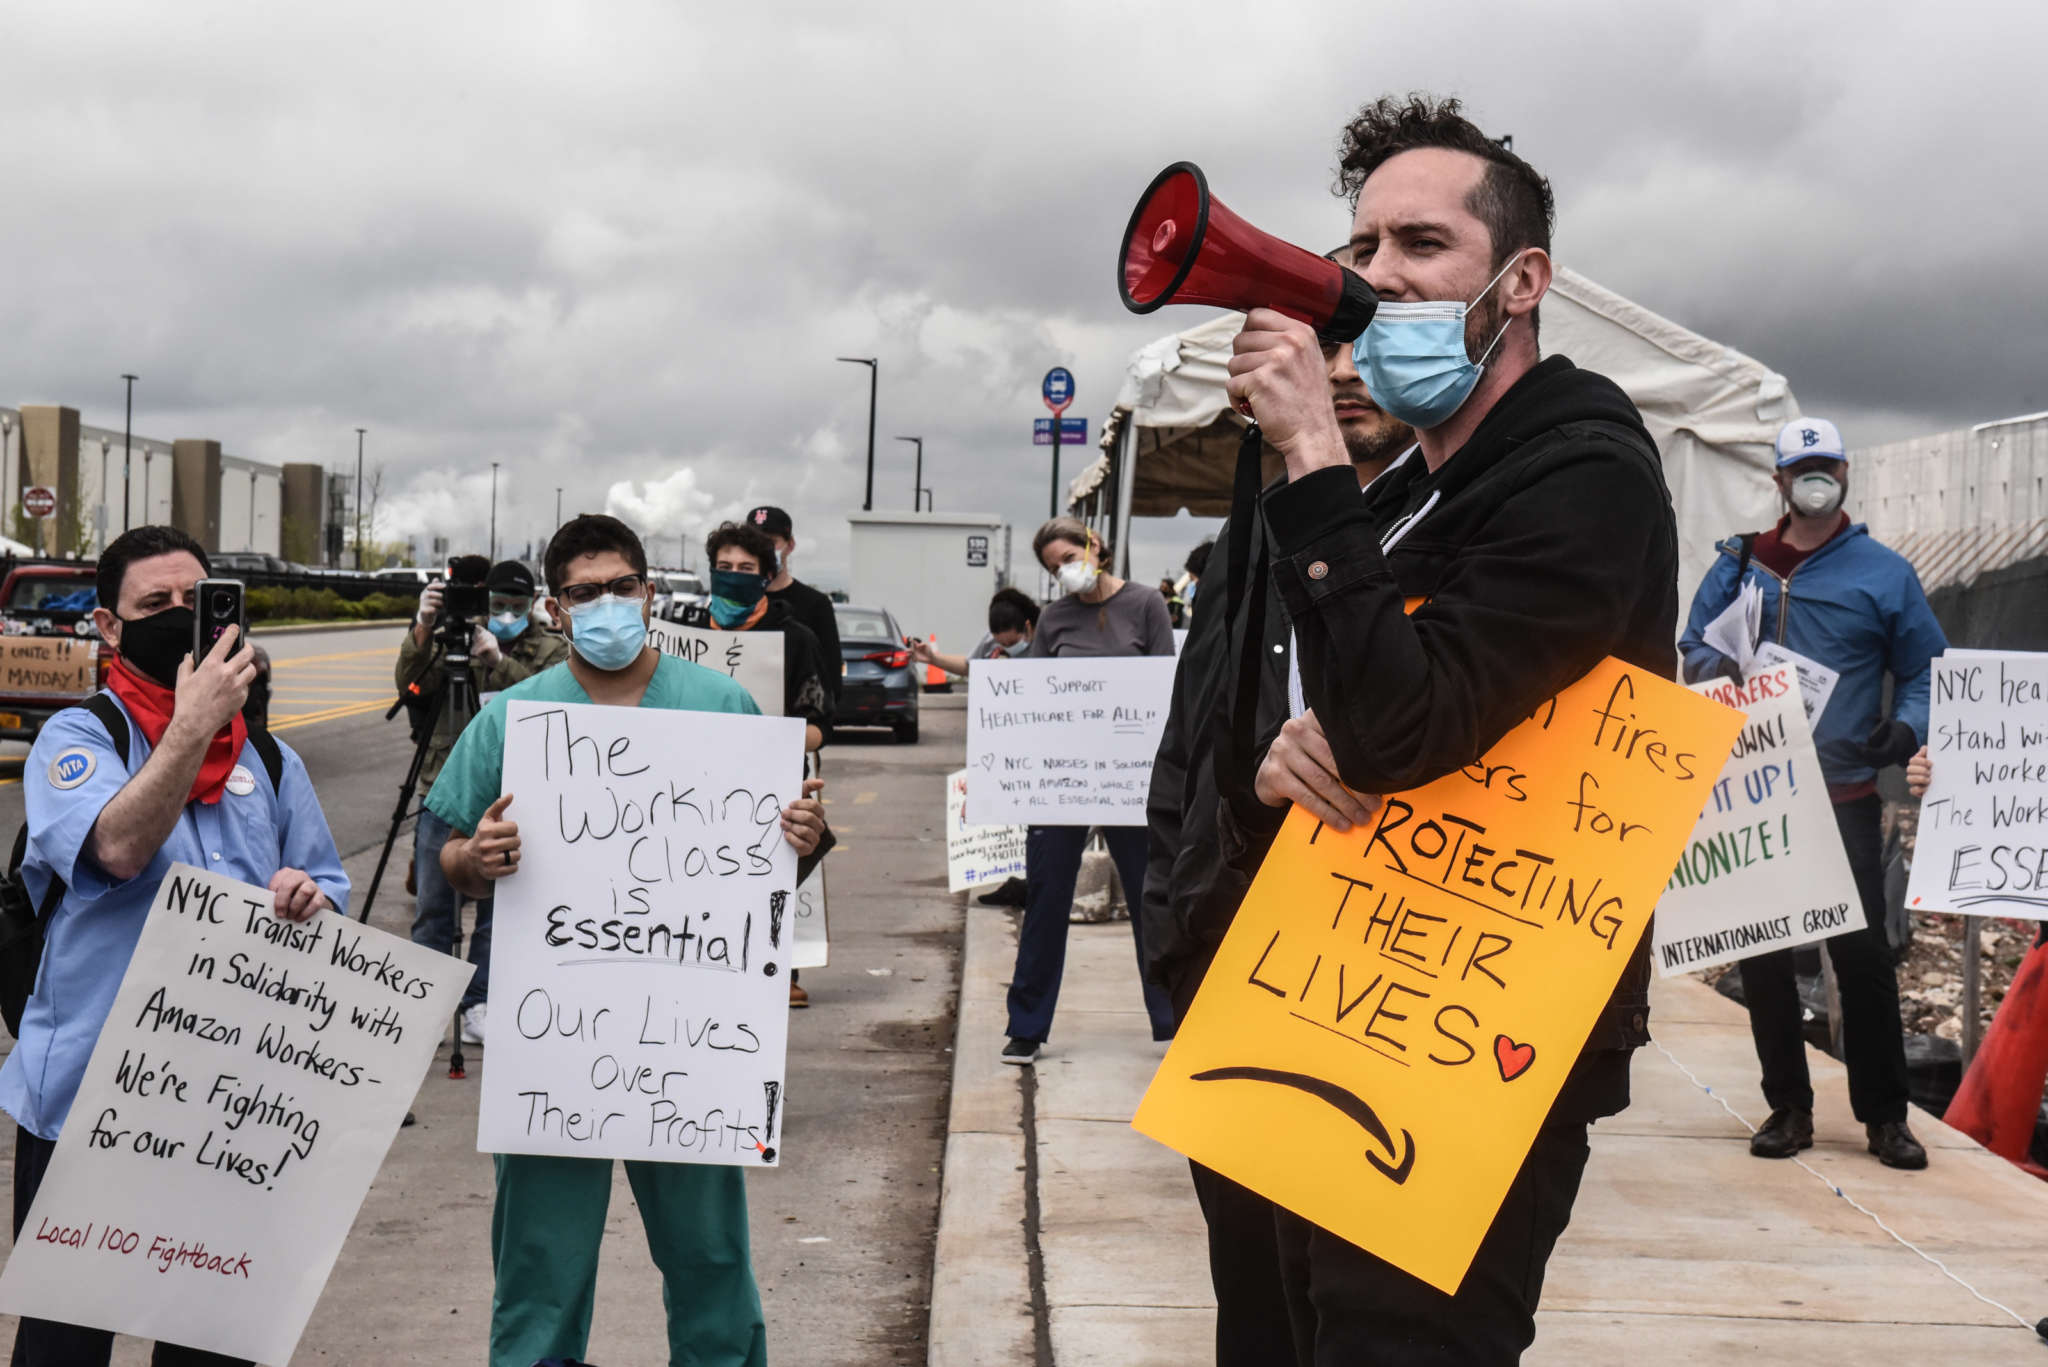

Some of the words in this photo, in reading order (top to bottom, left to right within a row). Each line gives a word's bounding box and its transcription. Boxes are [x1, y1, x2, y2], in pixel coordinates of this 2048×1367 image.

[649, 629, 709, 664] TRUMP
[987, 676, 1025, 697] WE
[1705, 670, 1790, 709] ORKERS
[1937, 666, 1983, 704] NYC
[517, 709, 650, 781] The
[979, 707, 1075, 730] HEALTHCARE
[1083, 708, 1105, 720] FOR
[1593, 674, 1697, 783] fires
[1938, 719, 2006, 751] Stand
[57, 759, 84, 779] MTA
[1000, 780, 1032, 792] WITH
[1004, 757, 1033, 771] NYC
[1043, 758, 1089, 770] NURSES
[1745, 759, 1798, 804] UP!
[559, 781, 785, 868] Working
[1567, 771, 1653, 843] for
[1927, 797, 1974, 829] The
[628, 836, 774, 884] Class
[1662, 814, 1791, 894] NIONIZE!
[609, 878, 651, 915] is
[166, 875, 228, 925] NYC
[243, 899, 323, 954] Transit
[330, 929, 434, 1000] Workers
[545, 889, 790, 977] Essential!
[1330, 872, 1514, 990] THEIR
[1662, 916, 1791, 969] INTERNATIONALIST
[1803, 903, 1850, 934] GROUP
[136, 986, 241, 1045] Amazon
[188, 937, 215, 979] in
[222, 954, 338, 1032] Solidarity
[351, 1004, 403, 1045] with
[517, 988, 611, 1042] Our
[639, 995, 760, 1054] Lives
[1247, 930, 1481, 1067] LIVES
[115, 1050, 188, 1102] We're
[207, 1074, 320, 1160] Fighting
[591, 1055, 689, 1099] Over
[89, 1108, 130, 1149] for
[133, 1131, 185, 1158] our
[196, 1131, 292, 1191] Lives!
[518, 1091, 625, 1141] Their
[648, 1080, 781, 1163] Profits!
[36, 1217, 90, 1249] Local
[98, 1225, 139, 1255] 100
[147, 1236, 252, 1279] Fightback
